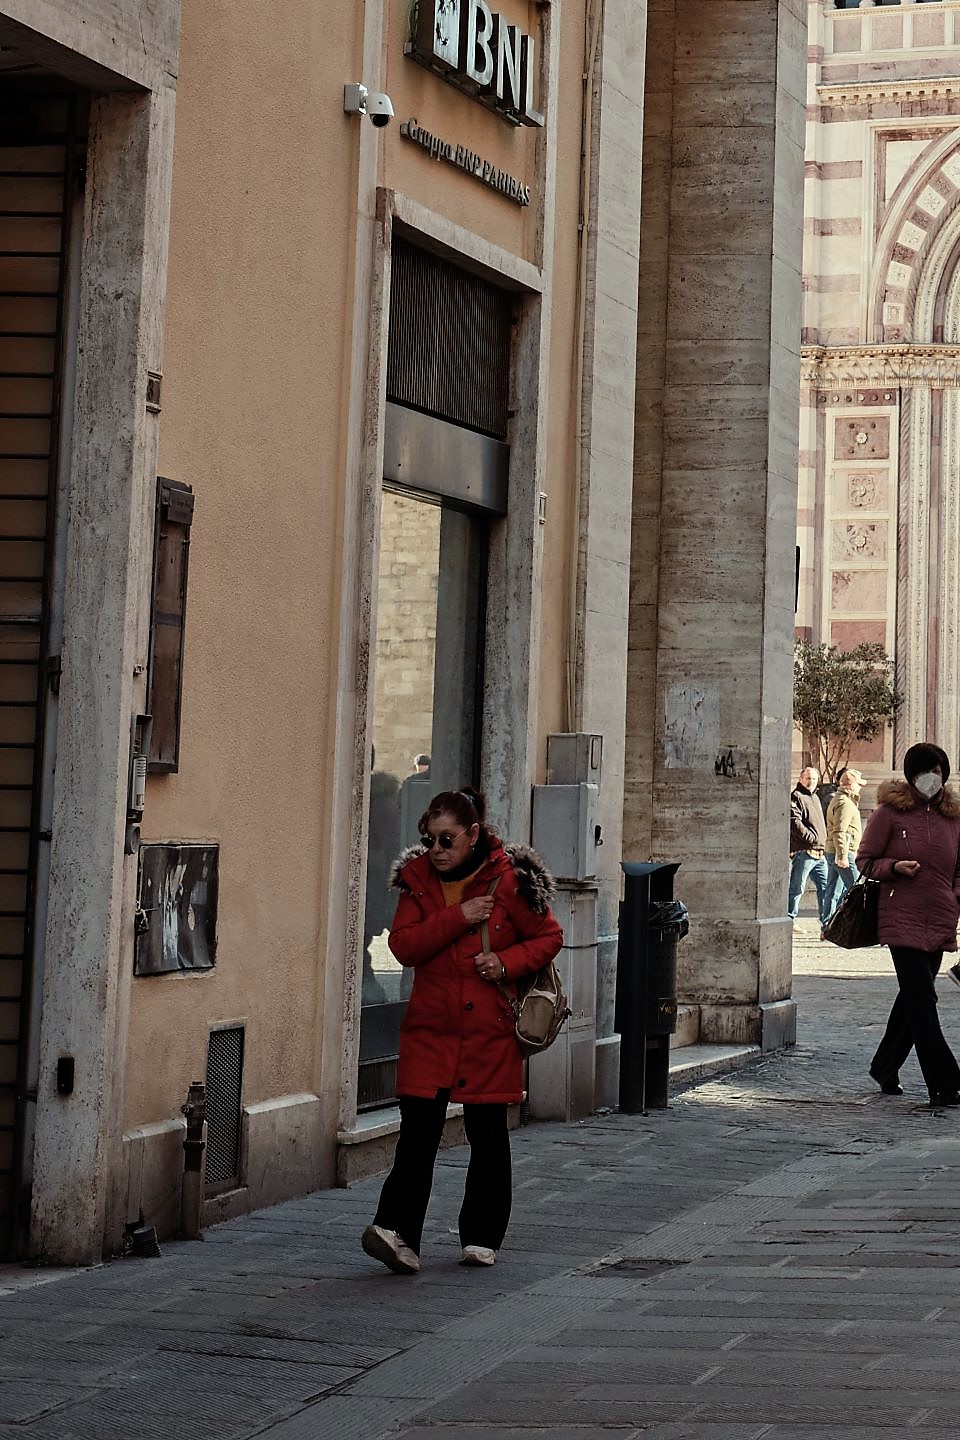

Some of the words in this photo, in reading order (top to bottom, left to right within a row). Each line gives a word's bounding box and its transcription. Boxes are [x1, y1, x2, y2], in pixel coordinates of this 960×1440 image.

[407, 117, 453, 161] Gruppo
[455, 143, 481, 174] BNP
[482, 159, 531, 205] PARIBAS
